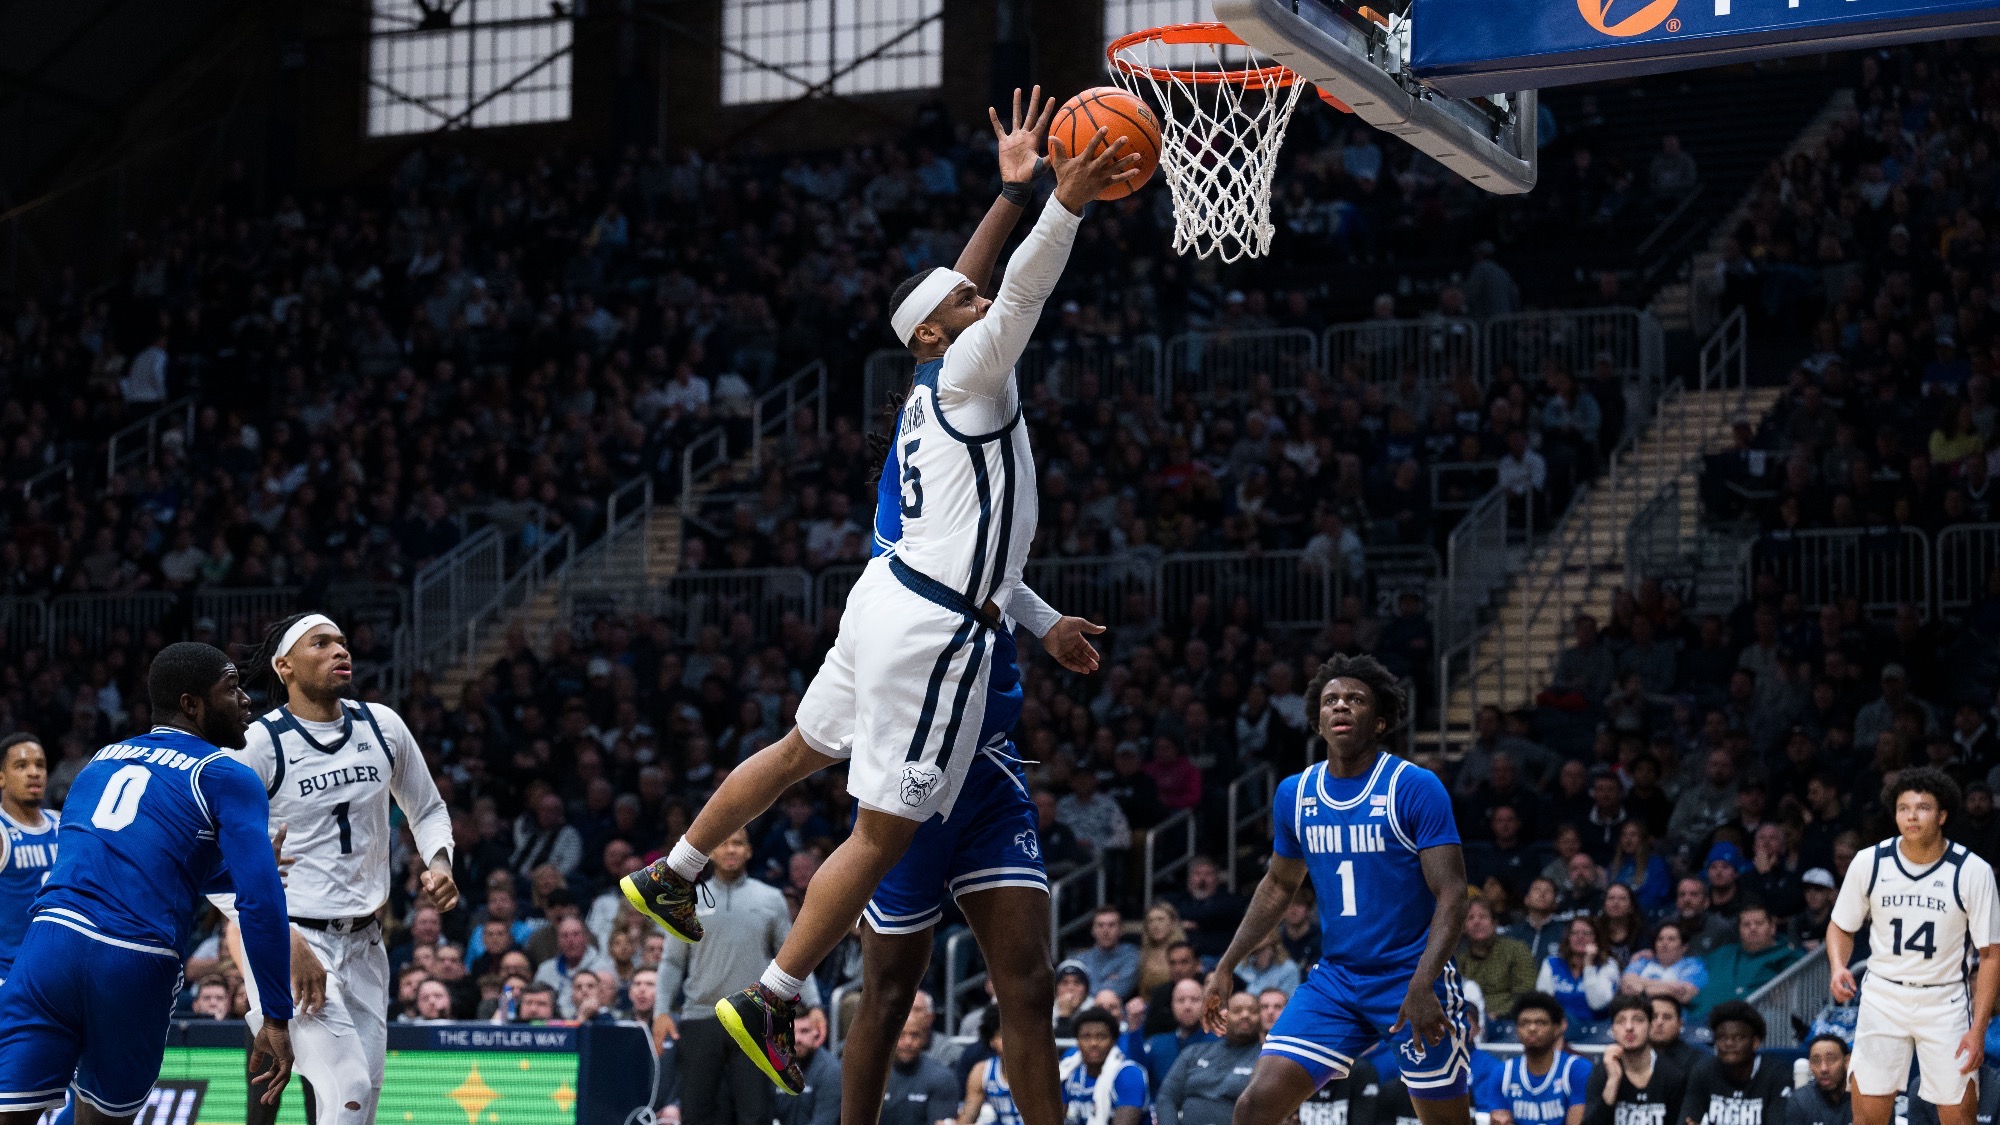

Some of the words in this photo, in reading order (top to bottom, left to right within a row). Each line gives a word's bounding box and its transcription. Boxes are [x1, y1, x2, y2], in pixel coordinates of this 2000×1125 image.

[901, 438, 923, 519] 5
[91, 764, 152, 832] 0
[298, 765, 381, 797] BUTLER
[331, 801, 352, 854] 1
[1305, 825, 1343, 853] SETON
[1349, 823, 1386, 853] HALL
[1335, 860, 1357, 916] 1
[1881, 895, 1947, 913] BUTLER
[1889, 917, 1937, 960] 14
[438, 1030, 468, 1045] THE
[471, 1030, 533, 1046] BUTLER
[534, 1032, 568, 1046] WAY
